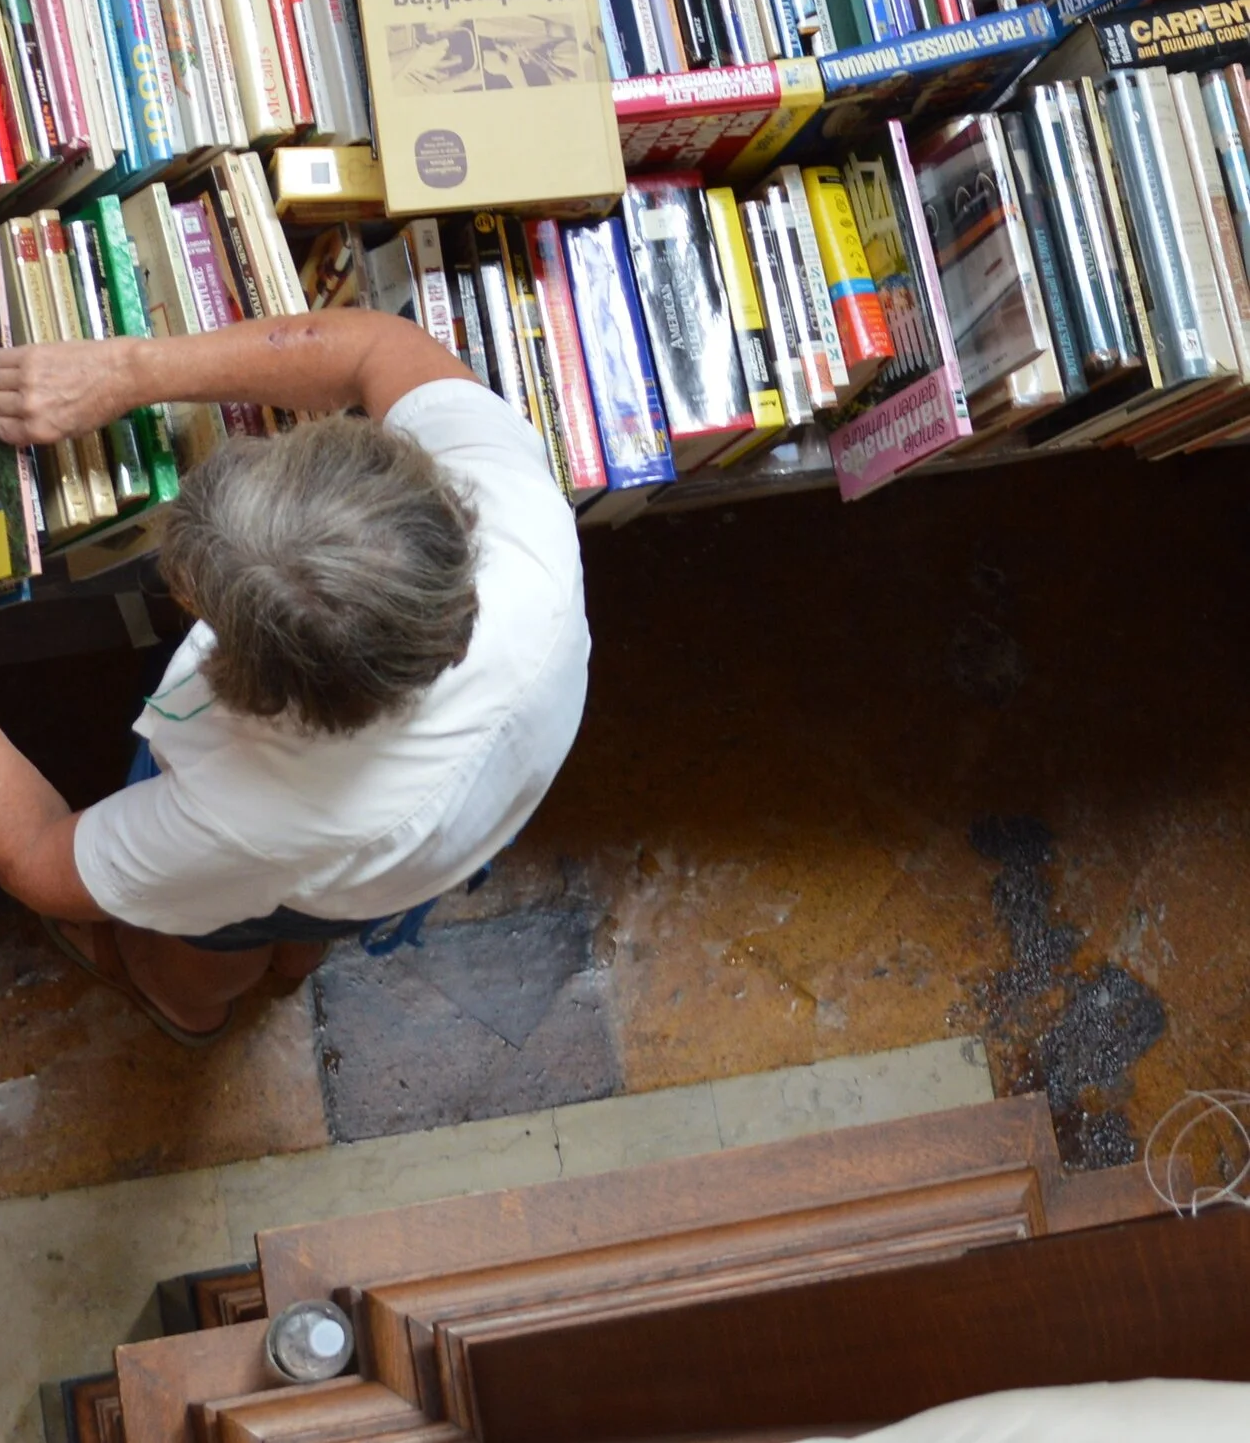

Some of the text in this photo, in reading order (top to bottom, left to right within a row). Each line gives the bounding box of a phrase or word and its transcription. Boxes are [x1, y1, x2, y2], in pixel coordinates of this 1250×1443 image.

[829, 46, 899, 82] MANUAL
[1137, 44, 1160, 60] and
[1160, 33, 1215, 56] BUILDING
[129, 42, 171, 148] 1000
[663, 78, 774, 106] NEW COMPLETE
[241, 274, 267, 319] ATALOG
[659, 281, 685, 350] AMERICAN
[894, 376, 938, 420] garden
